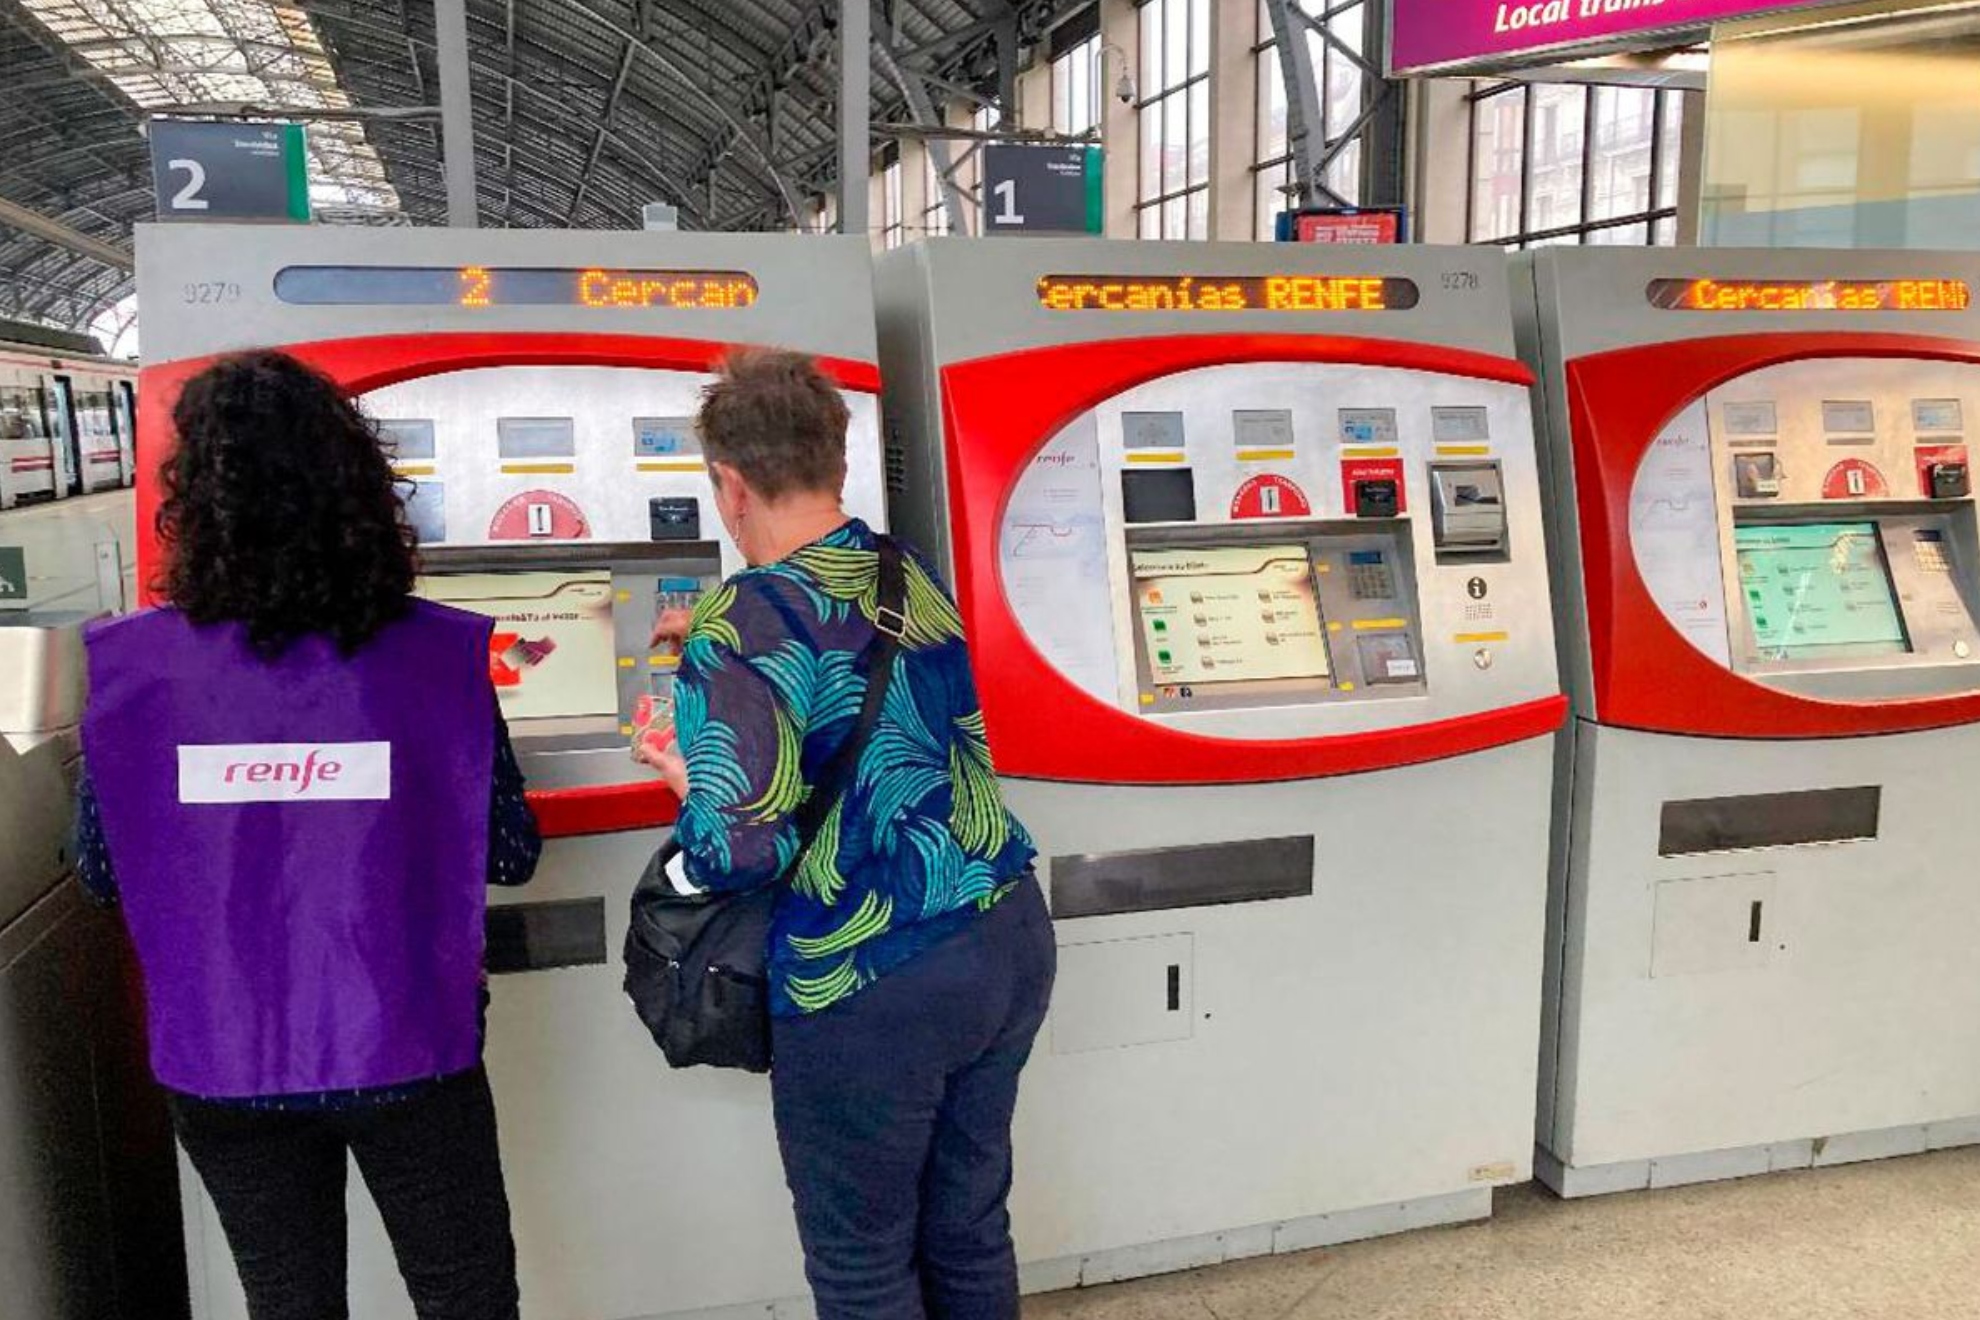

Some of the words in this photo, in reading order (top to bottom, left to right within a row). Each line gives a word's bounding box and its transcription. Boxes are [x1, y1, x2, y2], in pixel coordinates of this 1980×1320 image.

[1494, 0, 1569, 32] Local
[168, 158, 209, 209] 2
[994, 179, 1024, 224] 1
[460, 267, 490, 308] 2
[578, 269, 754, 309] Cercan
[1266, 278, 1385, 310] RENFE
[223, 749, 342, 794] renfe
